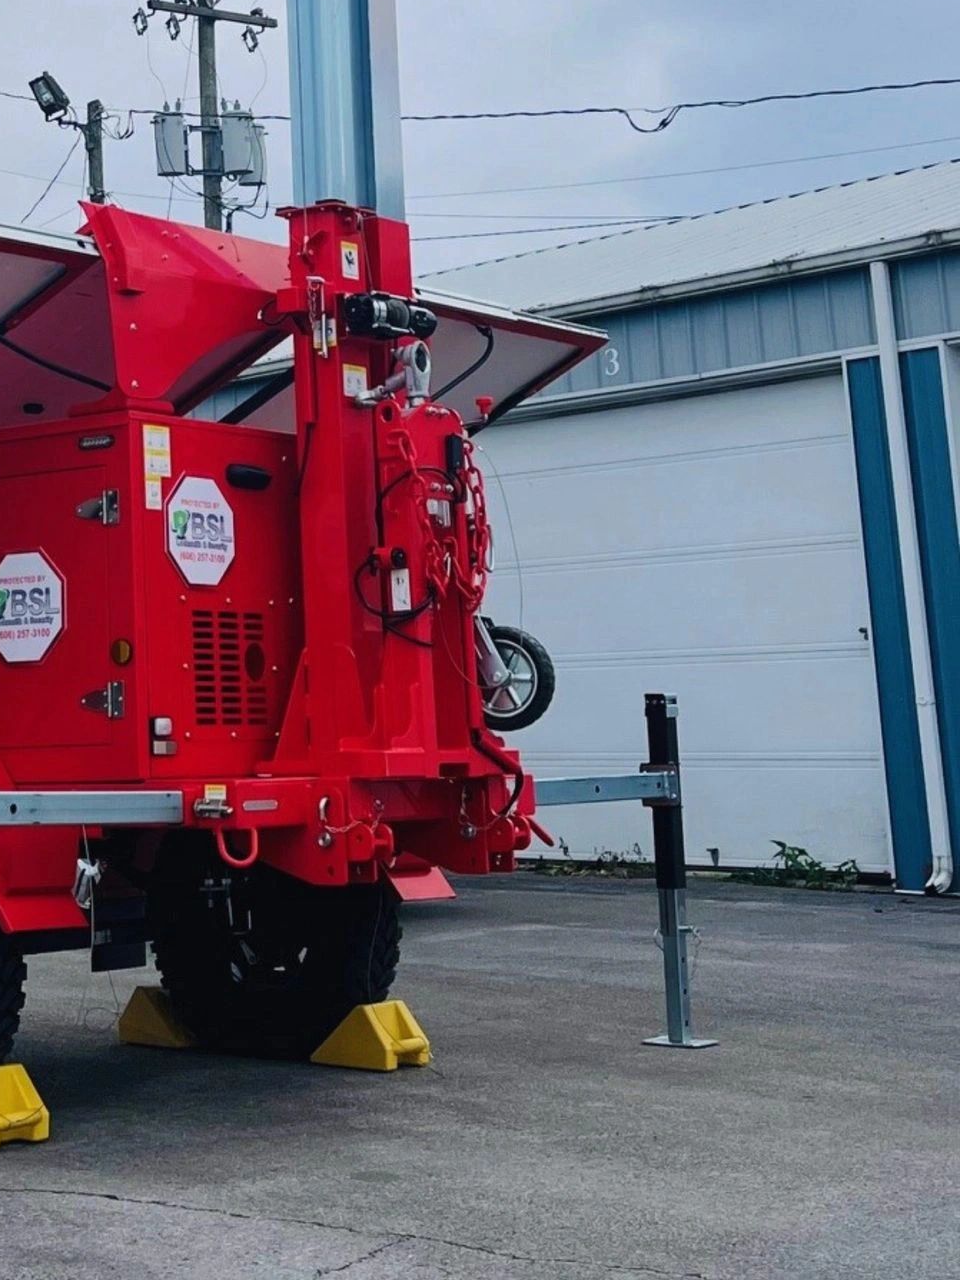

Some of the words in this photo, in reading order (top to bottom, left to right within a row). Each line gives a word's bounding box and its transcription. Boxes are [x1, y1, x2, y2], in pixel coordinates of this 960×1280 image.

[605, 348, 620, 376] 3
[191, 512, 232, 543] BSL
[11, 587, 59, 617] BSL
